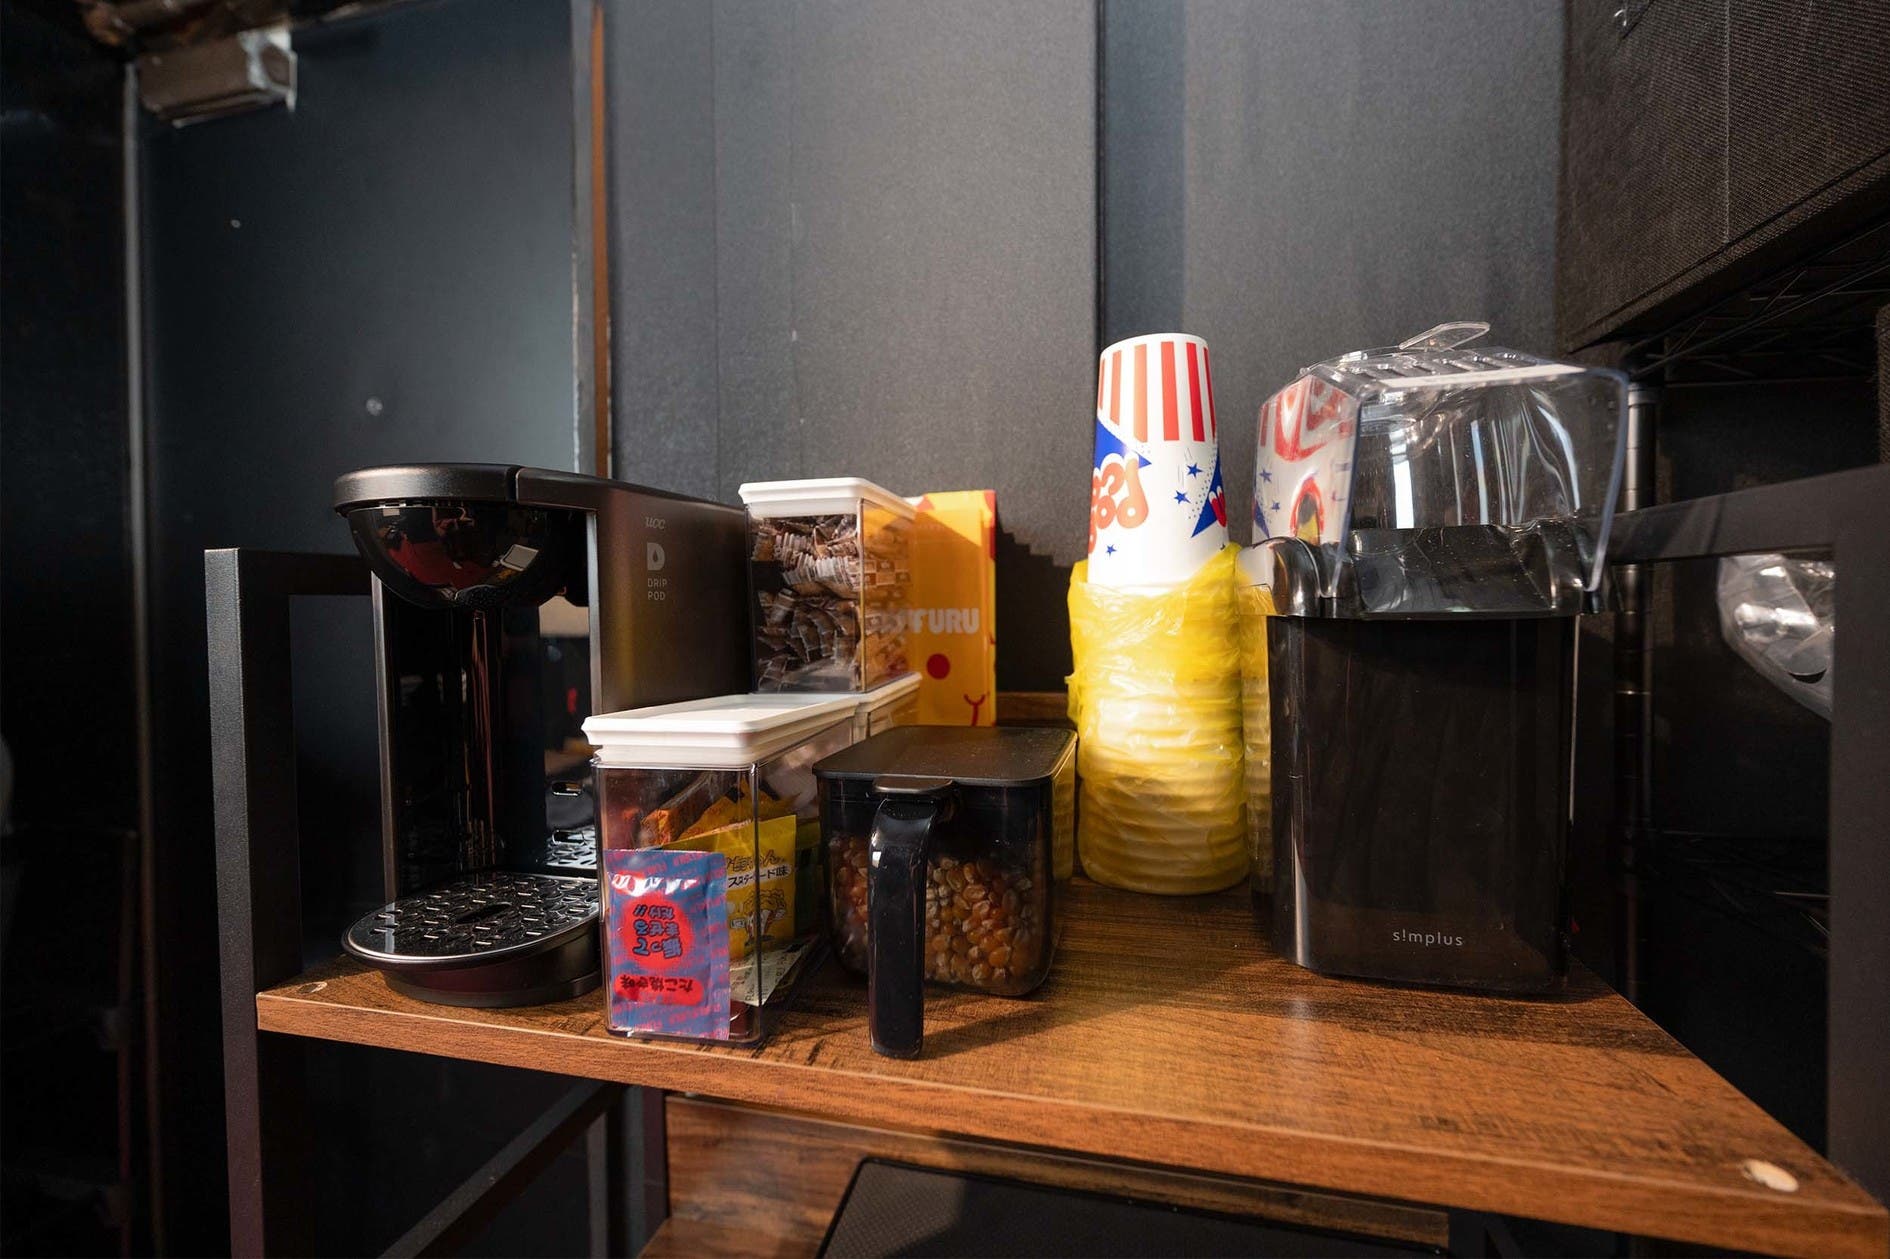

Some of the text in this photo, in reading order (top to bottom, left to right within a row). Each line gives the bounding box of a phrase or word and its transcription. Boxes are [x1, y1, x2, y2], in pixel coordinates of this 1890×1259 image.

[647, 578, 668, 588] DRIP
[647, 590, 666, 601] POD
[632, 920, 681, 938] まぜる
[632, 936, 684, 960] 振って
[620, 973, 694, 994] たこ焼き味
